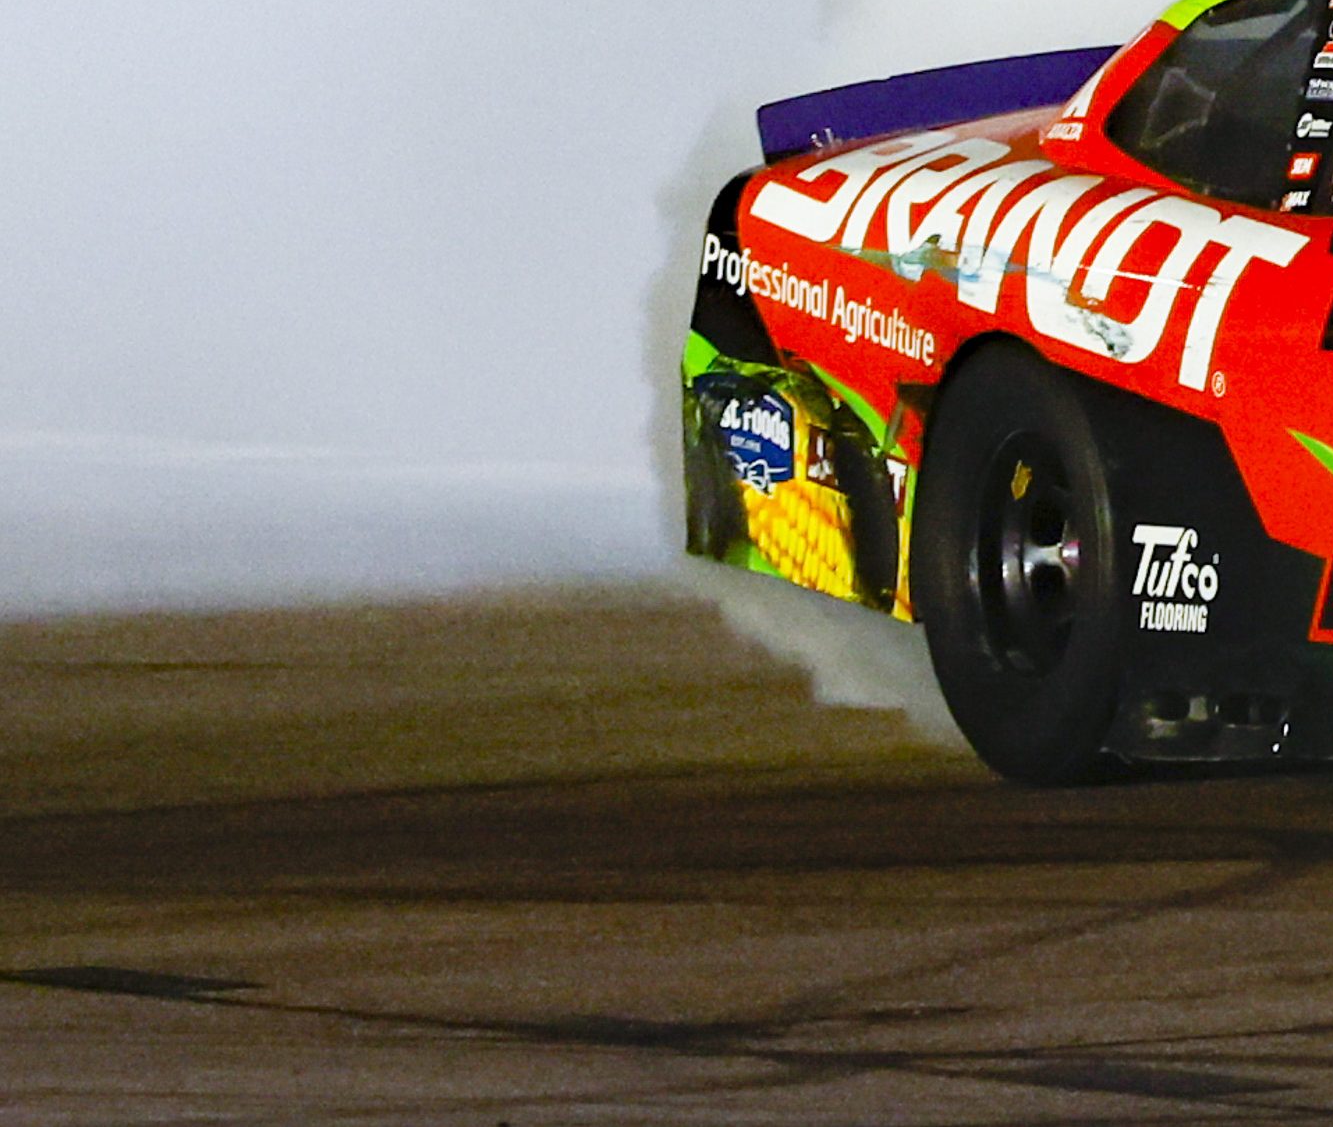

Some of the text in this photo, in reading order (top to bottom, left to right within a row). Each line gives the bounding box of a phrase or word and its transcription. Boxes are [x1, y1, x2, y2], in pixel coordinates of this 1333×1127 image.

[702, 233, 935, 367] Professional Agriculture
[750, 128, 1310, 392] BRANDT
[1131, 523, 1219, 602] Tufco
[1139, 600, 1209, 633] FLOORING
